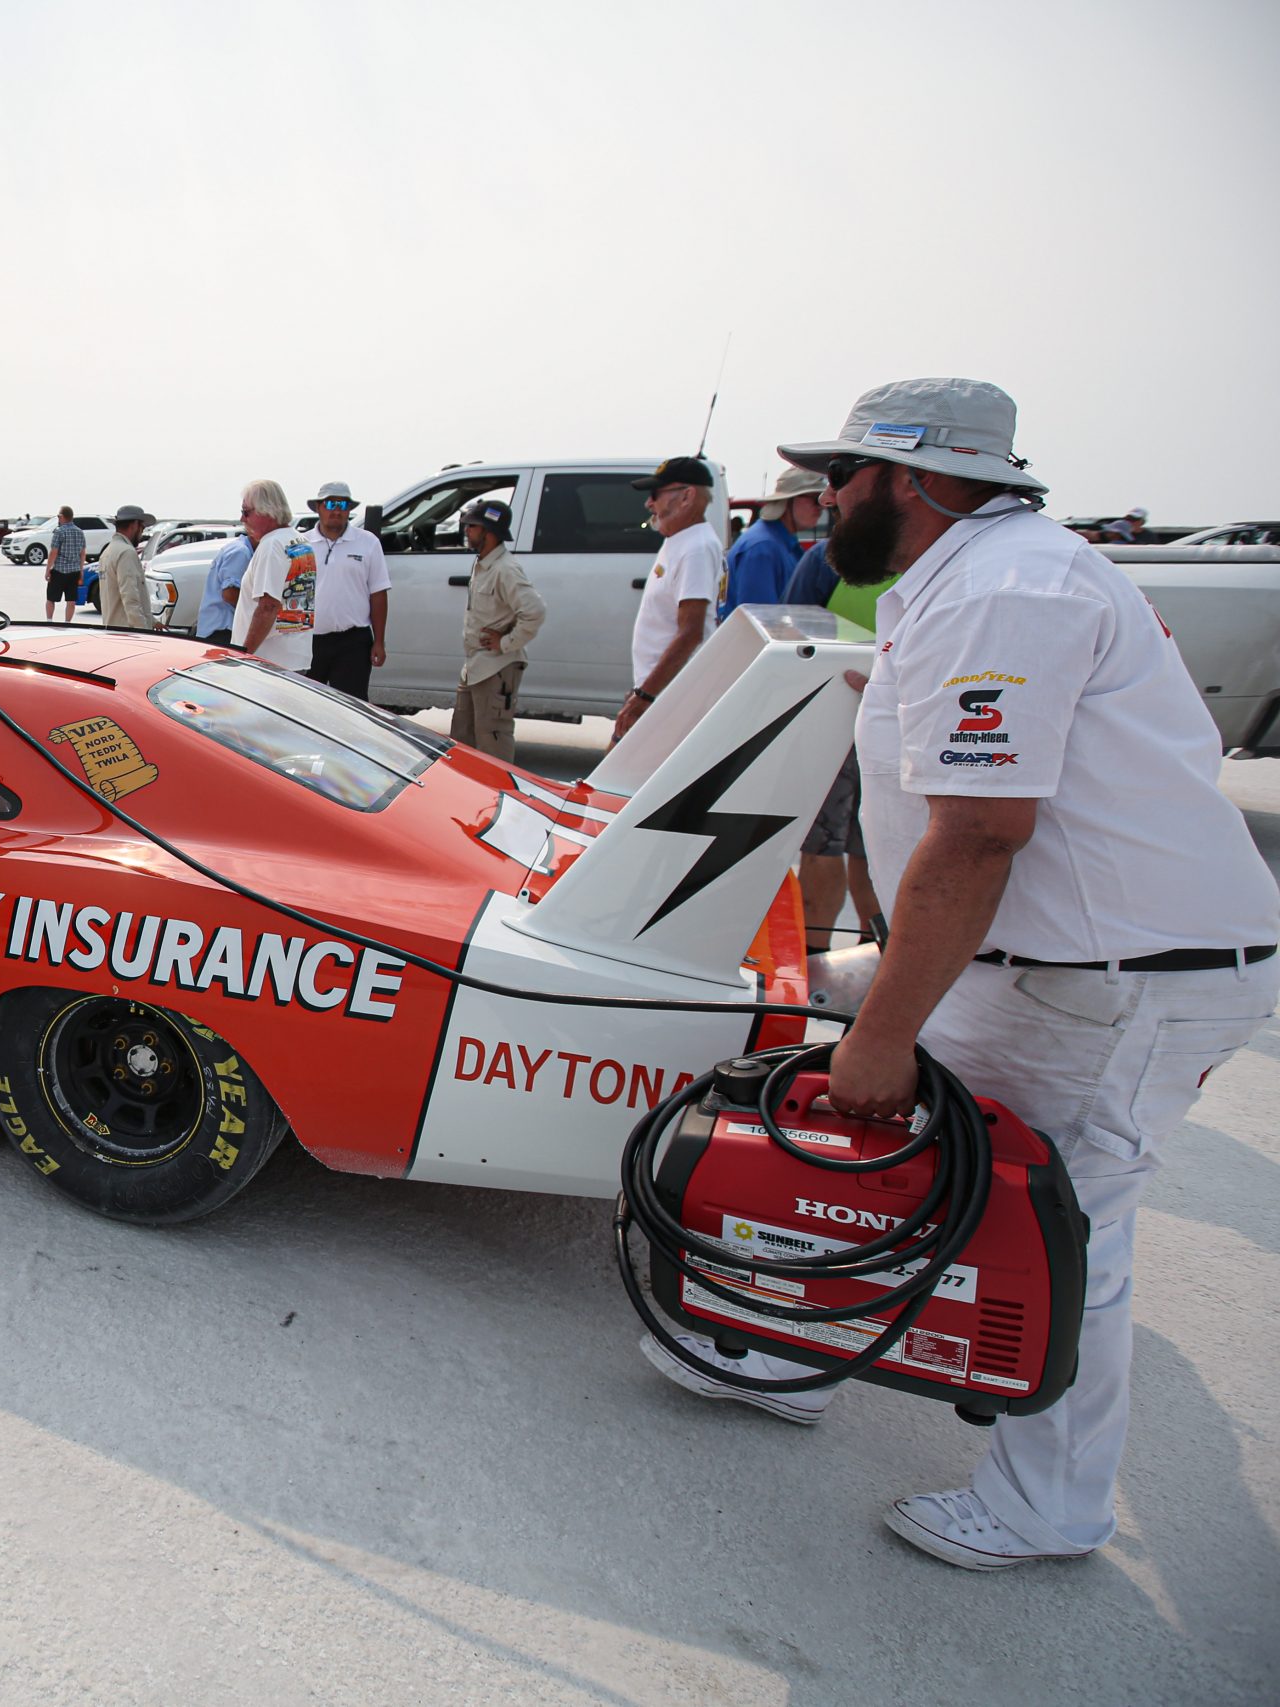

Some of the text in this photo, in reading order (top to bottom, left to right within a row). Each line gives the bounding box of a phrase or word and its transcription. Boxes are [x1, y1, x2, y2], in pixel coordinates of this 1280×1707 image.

[943, 670, 1027, 688] GOODYEAR
[68, 720, 109, 738] VIP
[85, 734, 115, 749] NORD
[89, 742, 123, 759] TEDDY
[95, 753, 130, 768] TWILA
[6, 895, 407, 1022] INSURANCE
[209, 1054, 247, 1170] YEAR
[750, 1126, 829, 1142] 1065660
[794, 1198, 938, 1238] HON
[757, 1230, 815, 1251] SUNBELT
